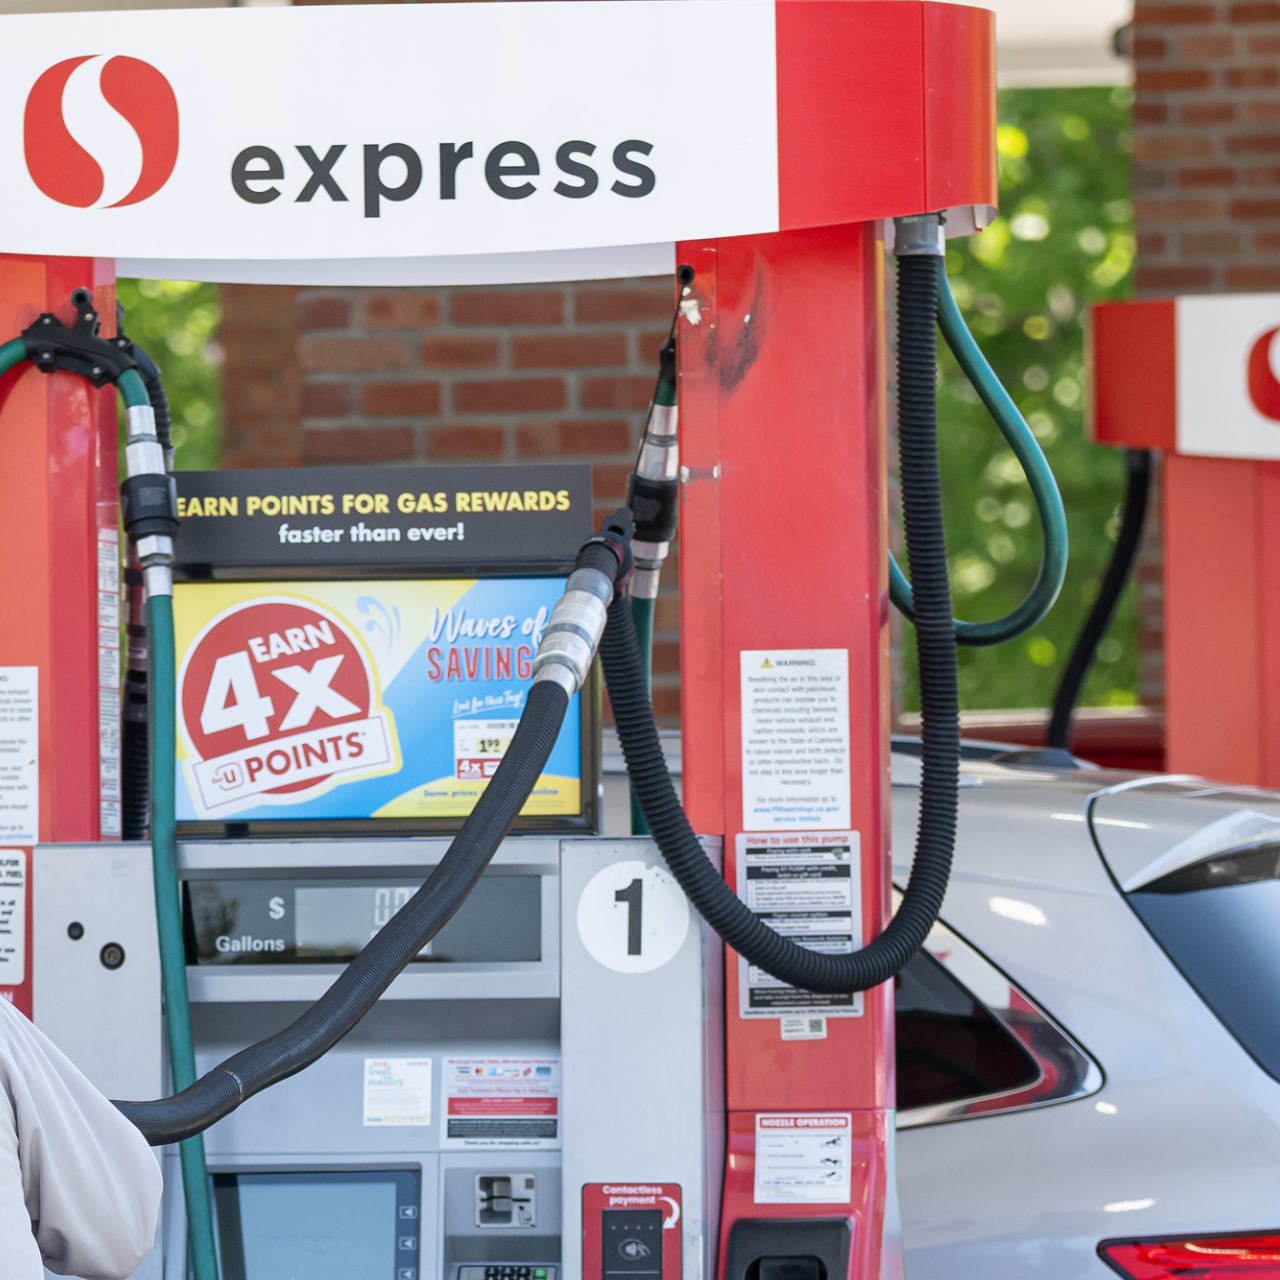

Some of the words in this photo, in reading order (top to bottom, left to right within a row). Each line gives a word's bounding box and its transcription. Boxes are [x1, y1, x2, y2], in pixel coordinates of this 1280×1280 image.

[231, 138, 656, 218] express
[175, 496, 238, 517] EARN
[246, 494, 335, 516] POINTS
[342, 494, 389, 514] FOR
[397, 492, 448, 513] GAS
[456, 490, 571, 512] REWARDS
[279, 524, 344, 544] faster
[350, 523, 401, 542] than
[406, 522, 465, 542] ever!
[428, 605, 517, 643] Waves
[521, 606, 548, 647] of
[248, 620, 336, 663] EARN
[427, 645, 533, 680] SAVING
[246, 731, 365, 782] POINTS
[268, 896, 285, 920] $
[615, 878, 643, 956] 1
[215, 935, 285, 953] Gallons
[796, 1118, 846, 1127] OPERATION
[602, 1185, 662, 1194] Contactless
[609, 1196, 656, 1206] payment
